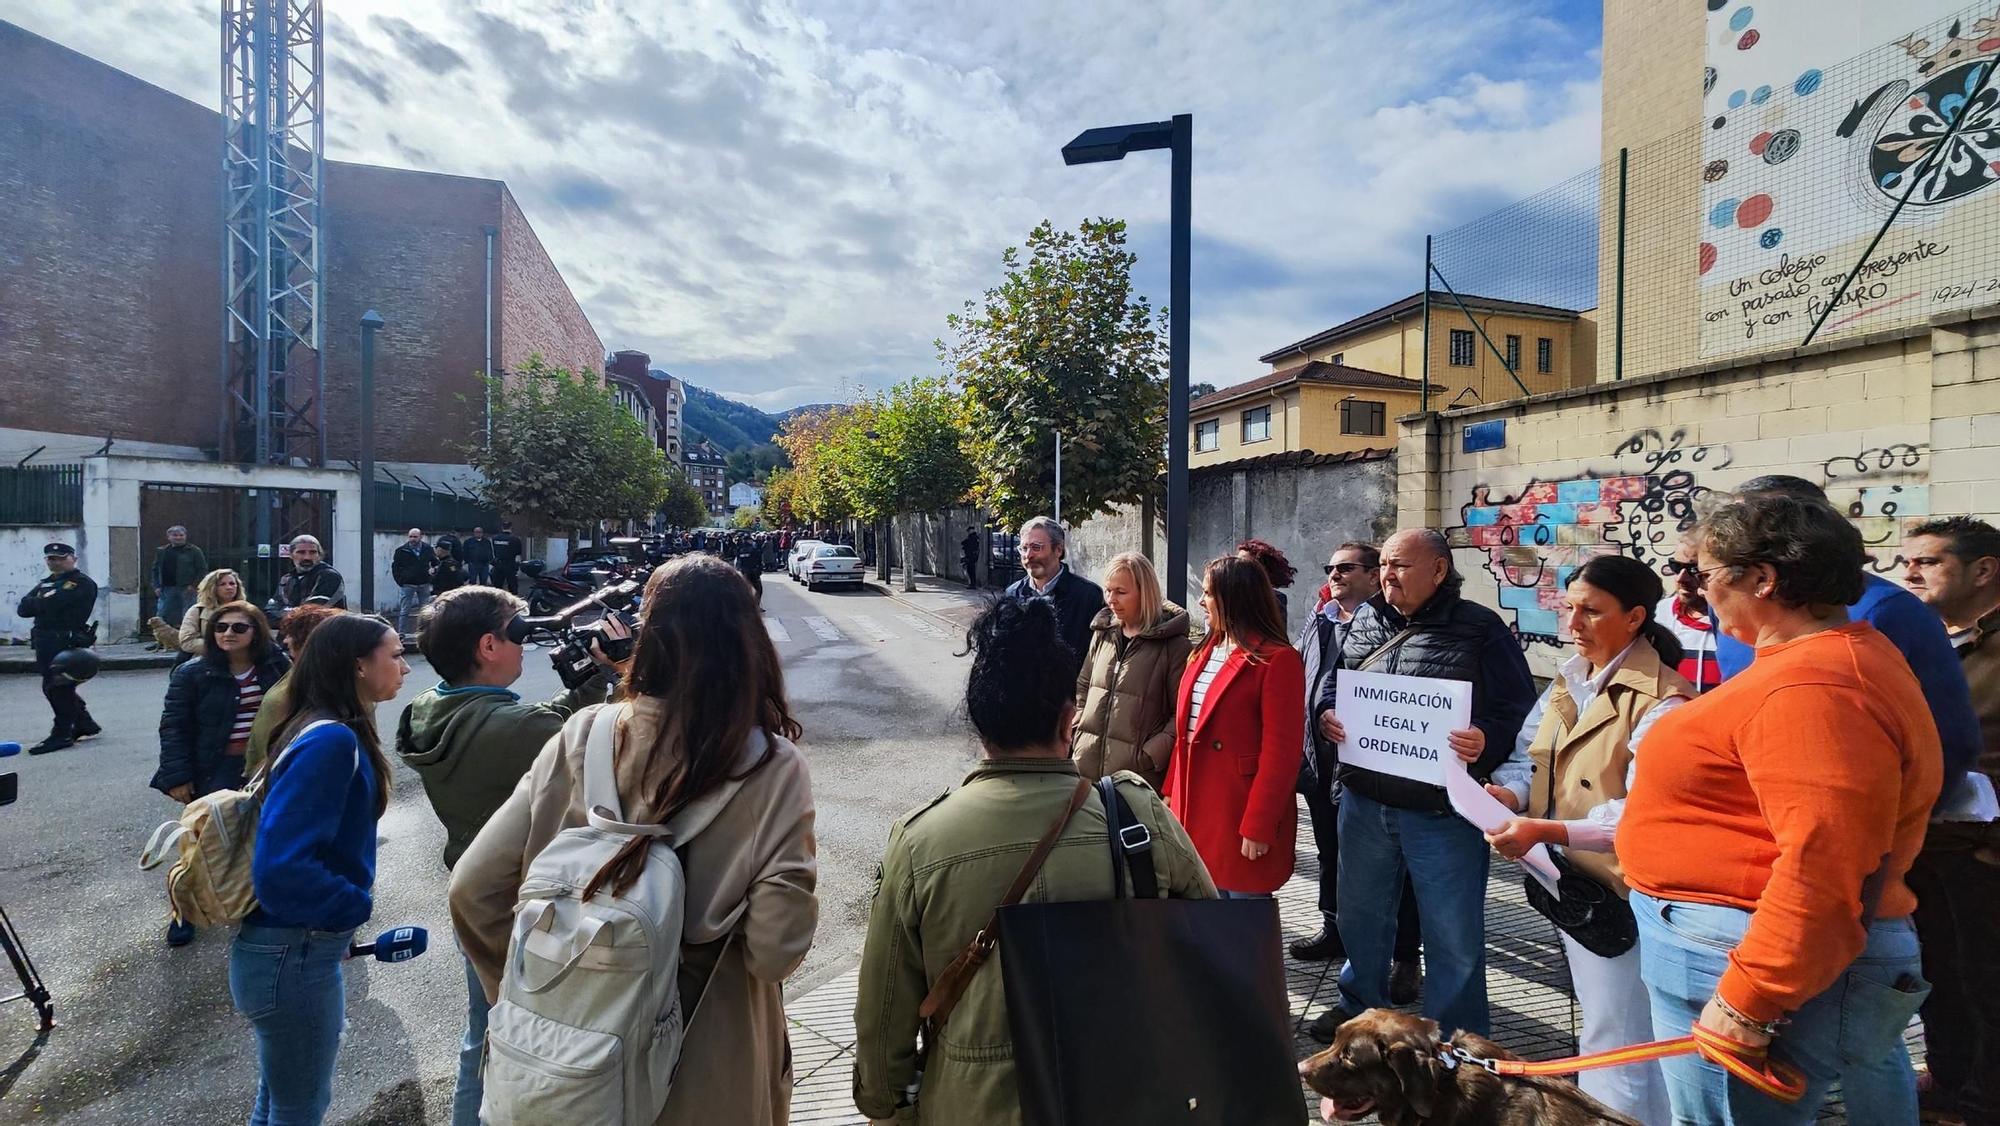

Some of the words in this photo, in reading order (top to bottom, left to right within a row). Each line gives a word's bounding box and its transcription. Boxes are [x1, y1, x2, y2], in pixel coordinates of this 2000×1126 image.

[1729, 277, 1753, 297] Un
[1760, 252, 1826, 285] Colegio
[1705, 309, 1730, 322] con
[1741, 282, 1811, 318] pasado
[1821, 272, 1849, 287] con
[1931, 278, 2000, 303] 1924-2
[1744, 318, 1758, 339] y
[1762, 310, 1792, 325] con
[1354, 686, 1452, 710] INMIGRACIÓN
[1374, 714, 1416, 732] LEGAL
[1421, 721, 1429, 734] Y
[1359, 736, 1439, 762] ORDENADA
